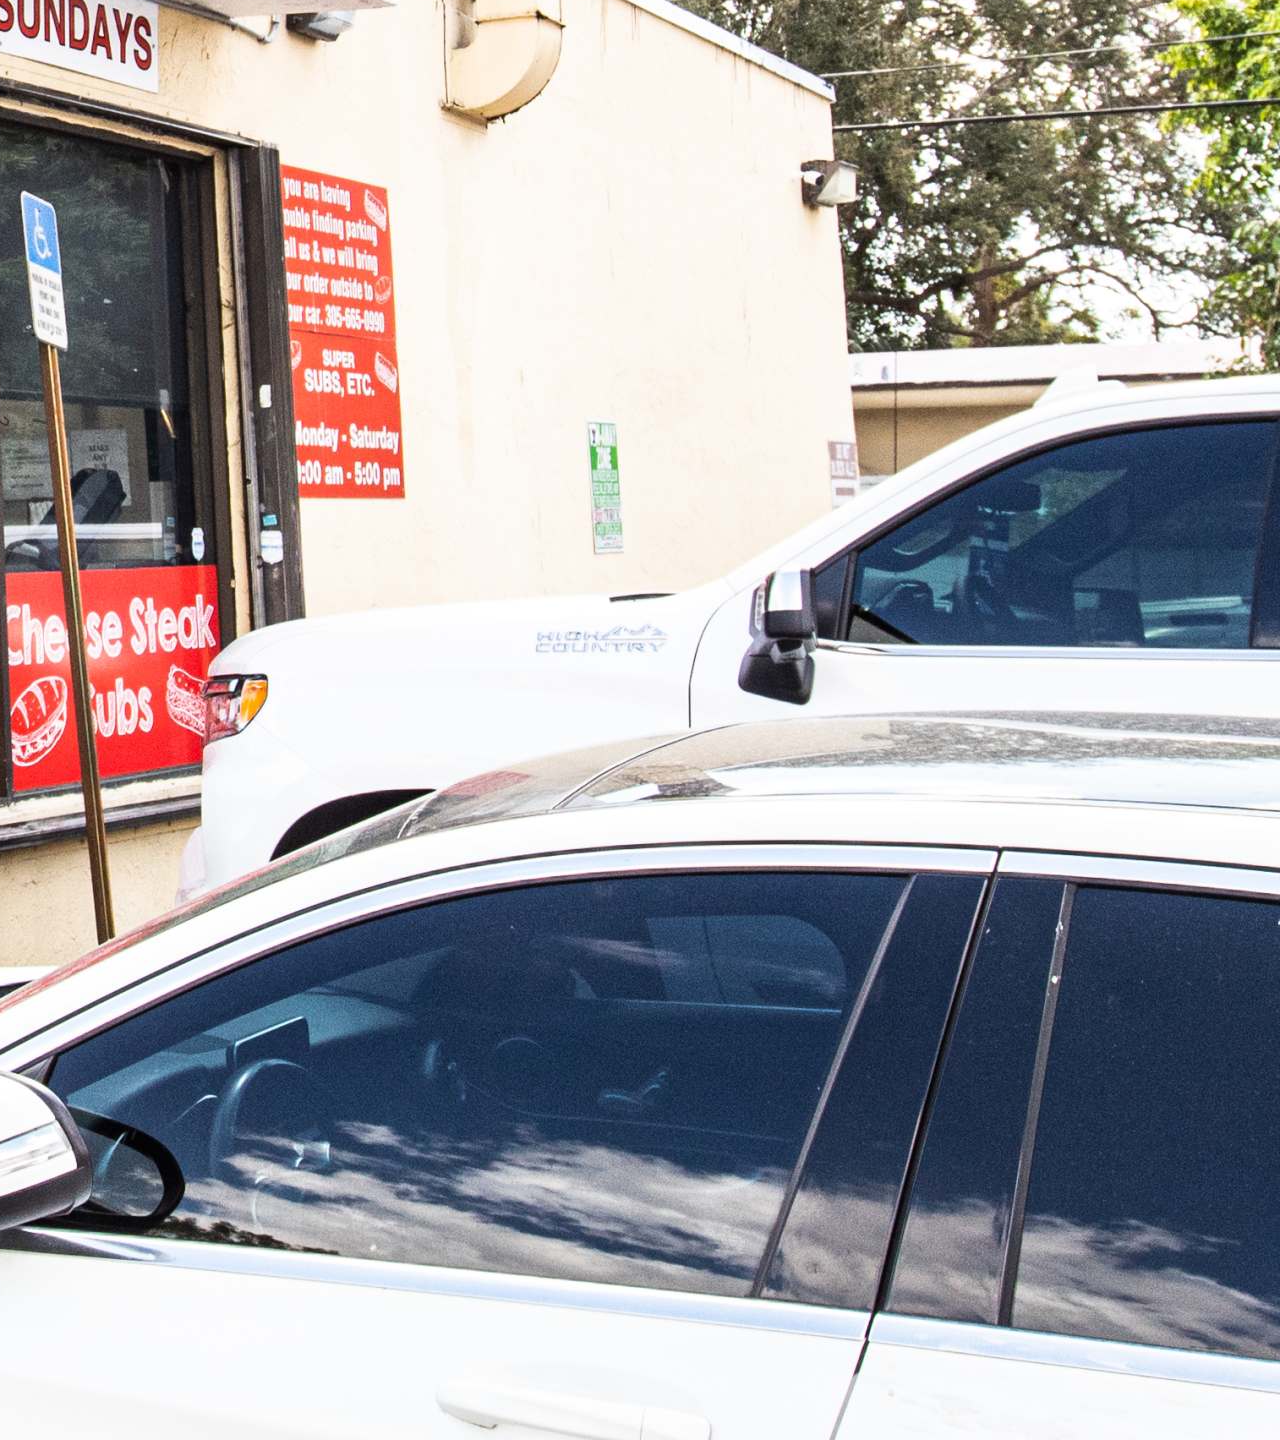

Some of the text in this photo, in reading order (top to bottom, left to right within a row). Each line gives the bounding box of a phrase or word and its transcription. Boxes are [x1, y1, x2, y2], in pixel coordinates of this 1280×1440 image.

[283, 176, 351, 212] you are having
[283, 206, 378, 247] ouble finding parking
[284, 236, 378, 276] all us & we will bring
[286, 271, 374, 301] our order outside to
[288, 303, 303, 322] our
[325, 303, 385, 333] 305-665-0990
[322, 348, 355, 369] SUPER
[304, 368, 375, 398] SUBS, ETC.
[349, 423, 399, 455] Saturday
[325, 464, 344, 485] am
[354, 461, 380, 486] 5:00
[383, 467, 400, 490] pm
[6, 595, 216, 666] Chese Steak
[537, 631, 601, 641] HIGH
[536, 642, 666, 653] COUNTRY
